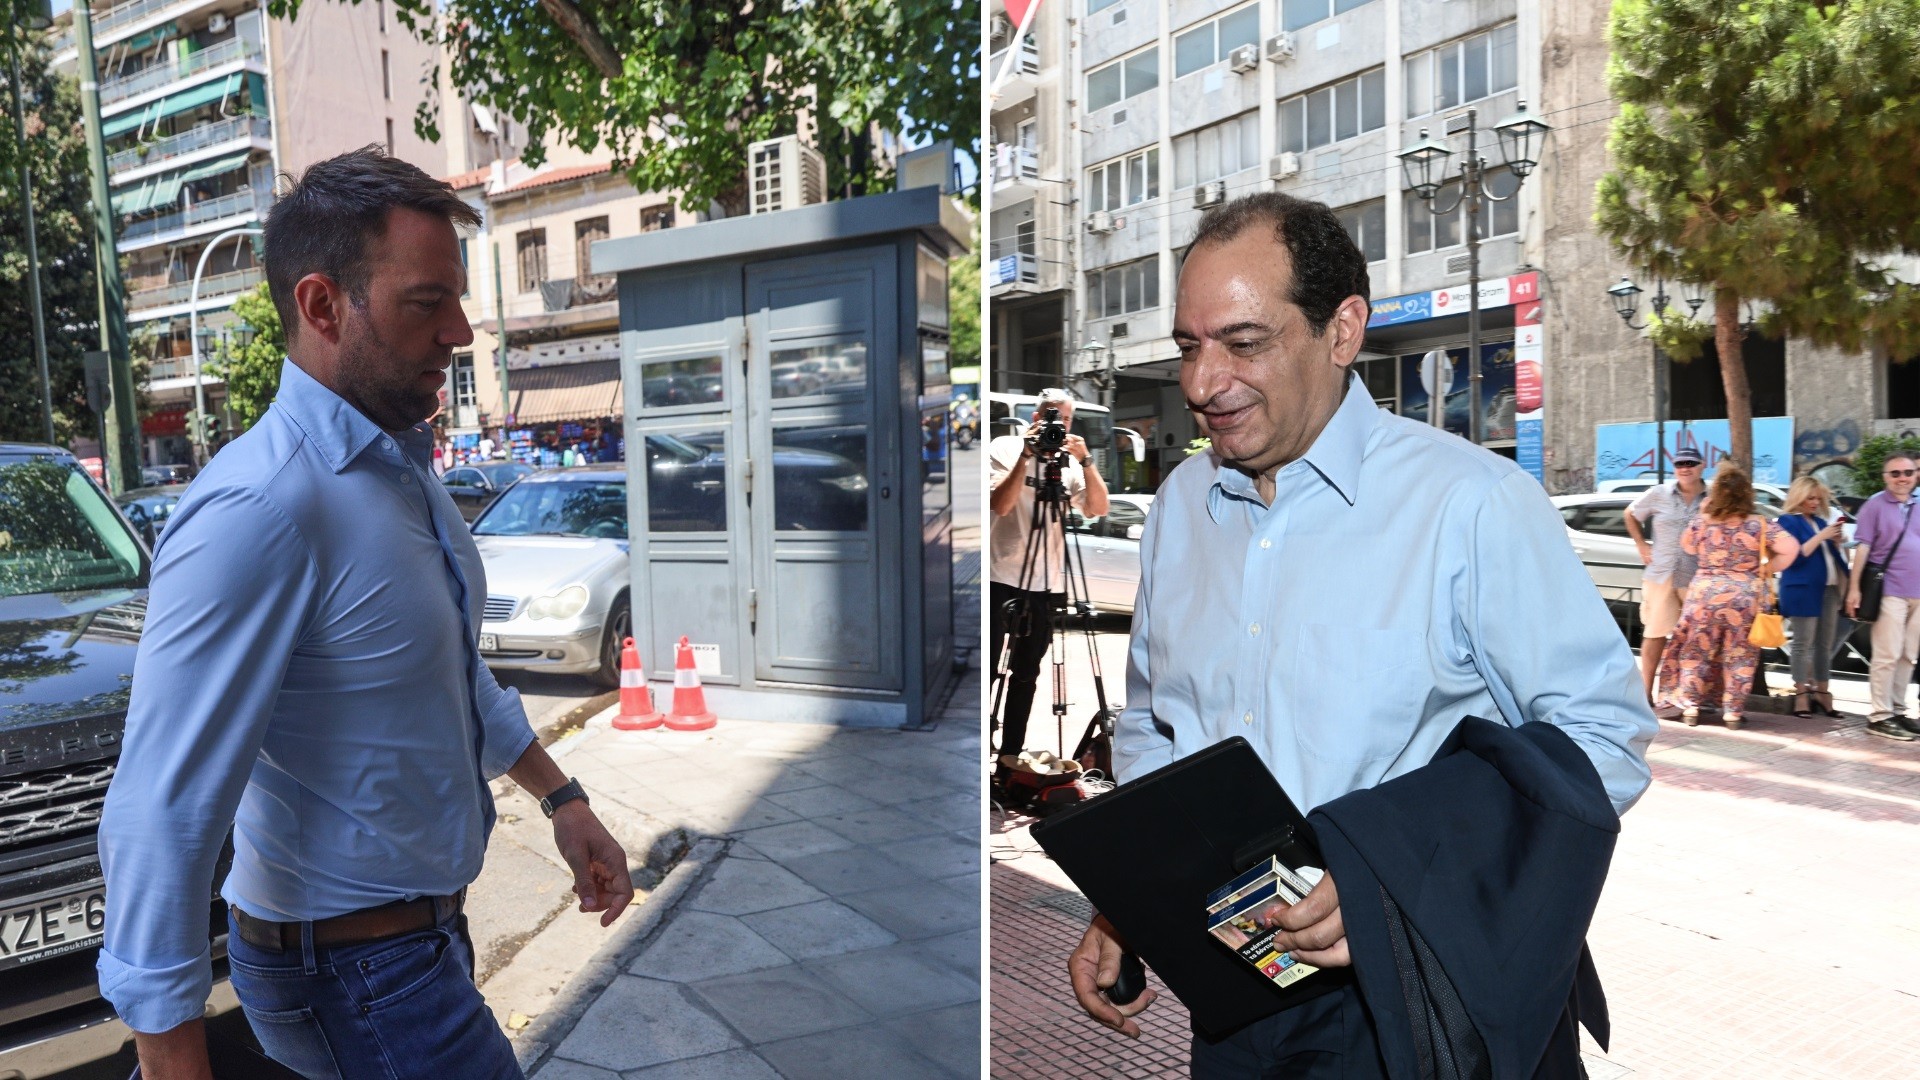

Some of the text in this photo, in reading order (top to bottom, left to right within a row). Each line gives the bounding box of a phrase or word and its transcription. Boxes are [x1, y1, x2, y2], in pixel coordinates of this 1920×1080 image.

[1451, 286, 1505, 303] MonGram
[1515, 282, 1532, 295] 41
[19, 936, 104, 963] www.manoukistun
